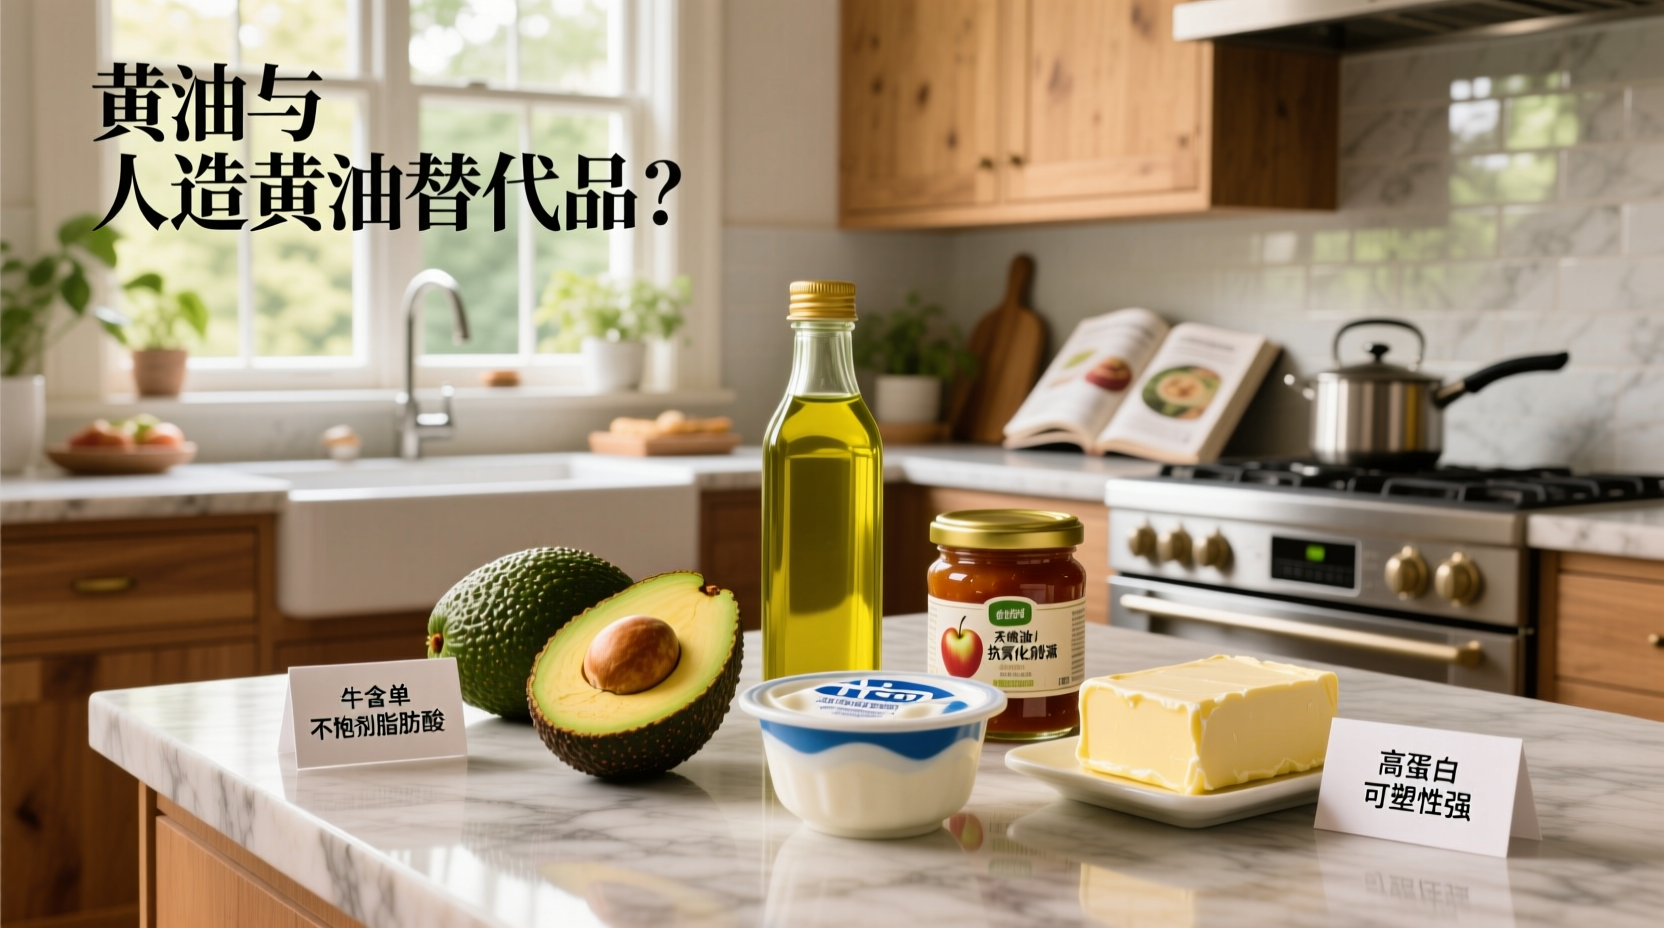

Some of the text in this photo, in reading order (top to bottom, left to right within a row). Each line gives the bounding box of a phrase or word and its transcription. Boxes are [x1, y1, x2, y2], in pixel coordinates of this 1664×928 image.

[341, 684, 411, 709] 牛含单
[1379, 749, 1458, 784] 高蛋白
[1364, 781, 1471, 821] 可塑性强
